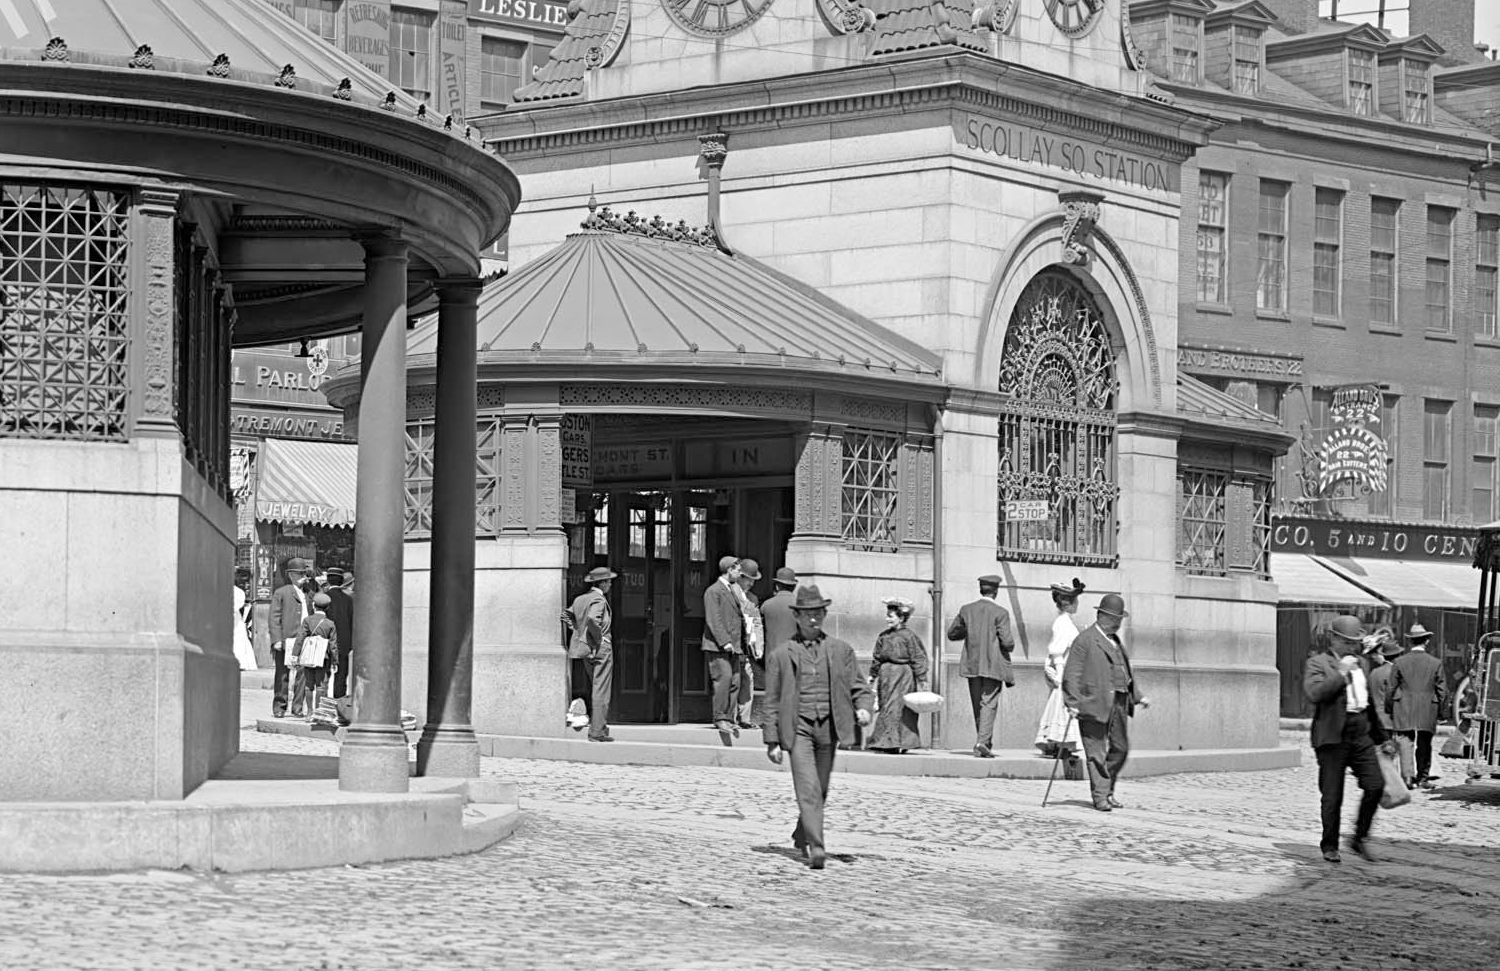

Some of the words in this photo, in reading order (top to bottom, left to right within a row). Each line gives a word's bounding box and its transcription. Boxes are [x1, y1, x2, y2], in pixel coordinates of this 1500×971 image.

[967, 118, 1054, 168] SCOLLAY
[1060, 141, 1086, 180] SQ
[1093, 149, 1169, 192] STATION
[1345, 408, 1365, 419] 22
[237, 414, 318, 436] TREMONT
[732, 447, 759, 465] IN
[1007, 502, 1017, 520] 2
[1018, 508, 1046, 519] STOP
[1274, 525, 1315, 547] CO.
[1328, 529, 1341, 548] 5
[1348, 534, 1375, 546] AND
